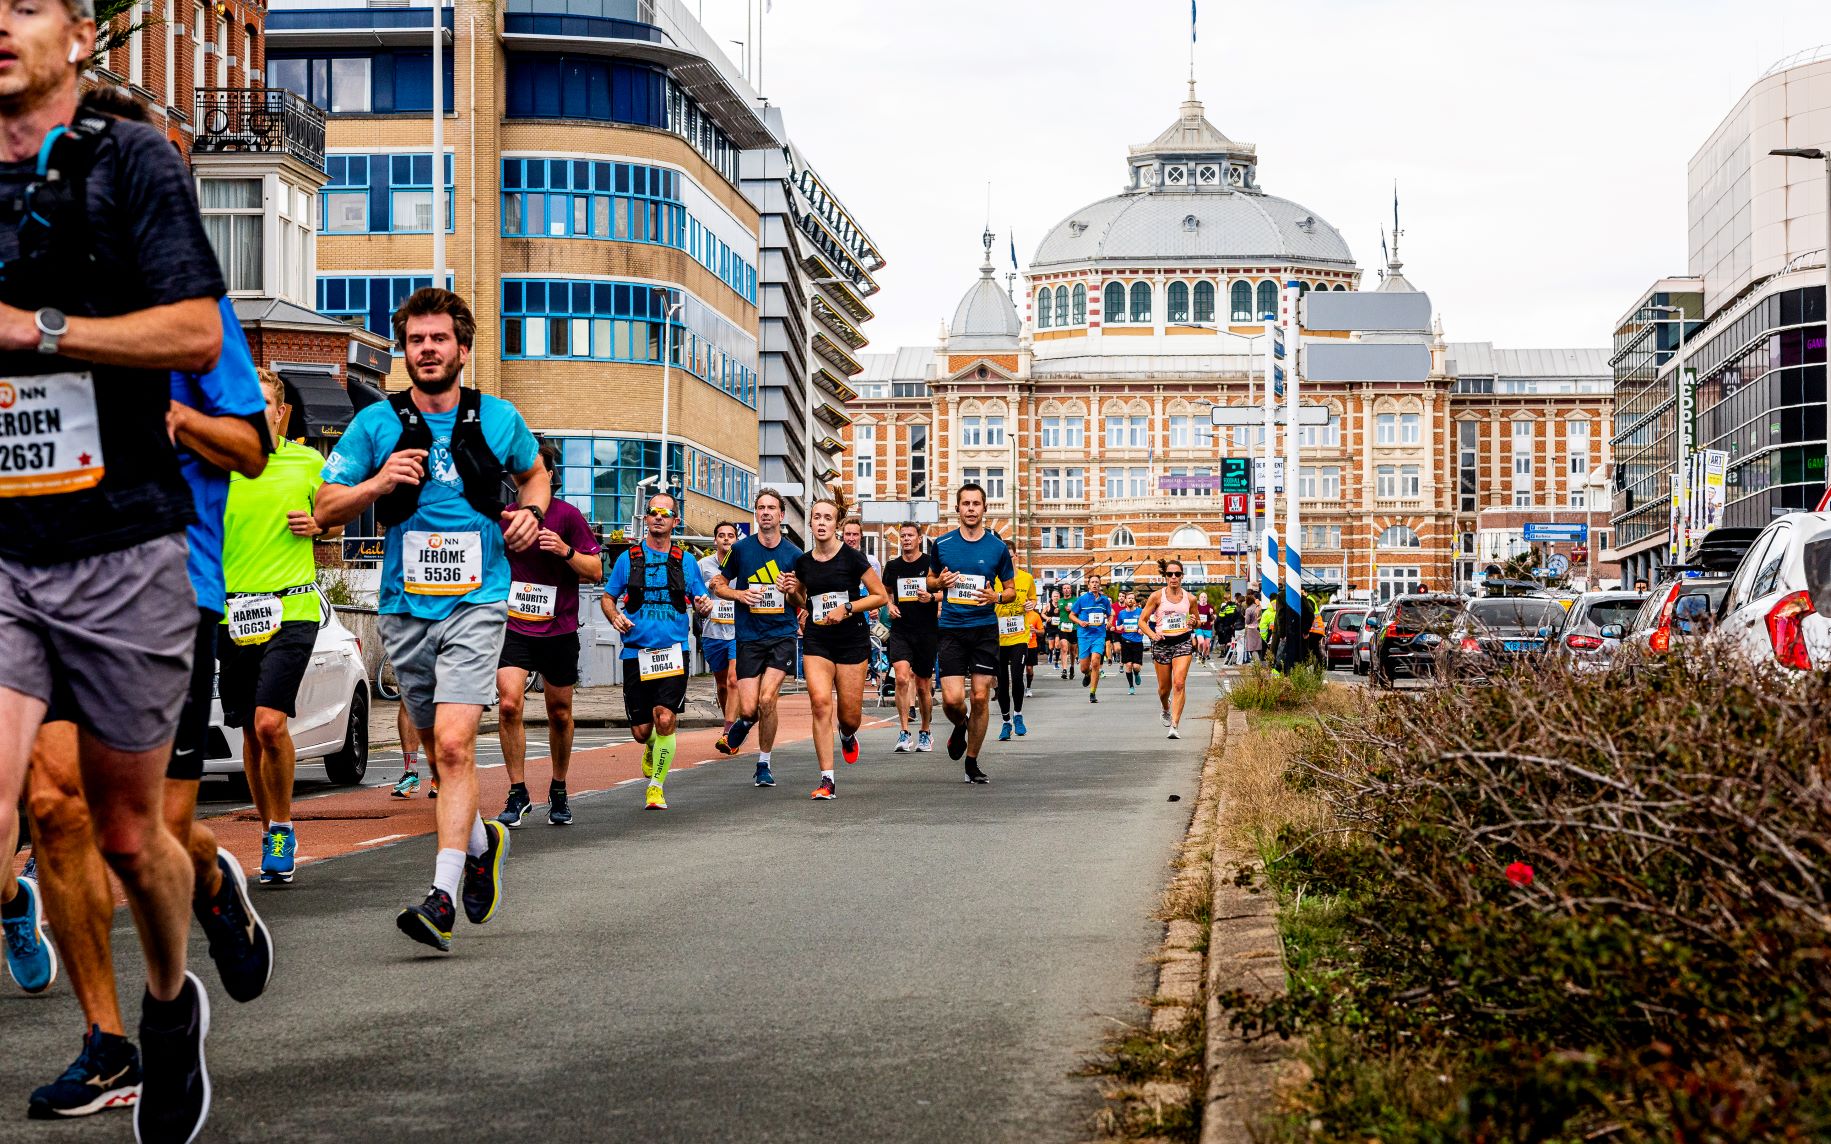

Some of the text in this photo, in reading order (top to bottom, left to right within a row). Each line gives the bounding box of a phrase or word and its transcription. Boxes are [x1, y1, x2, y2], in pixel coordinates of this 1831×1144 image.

[20, 387, 47, 400] NN
[0, 442, 55, 471] 2637
[418, 547, 466, 564] JÉRÔME
[424, 567, 462, 582] 5536
[515, 592, 549, 604] MAURITS
[233, 607, 272, 622] HARMEN
[520, 602, 541, 614] 3931
[238, 620, 271, 636] 16634
[651, 653, 670, 663] EDDY
[650, 661, 674, 673] 10644
